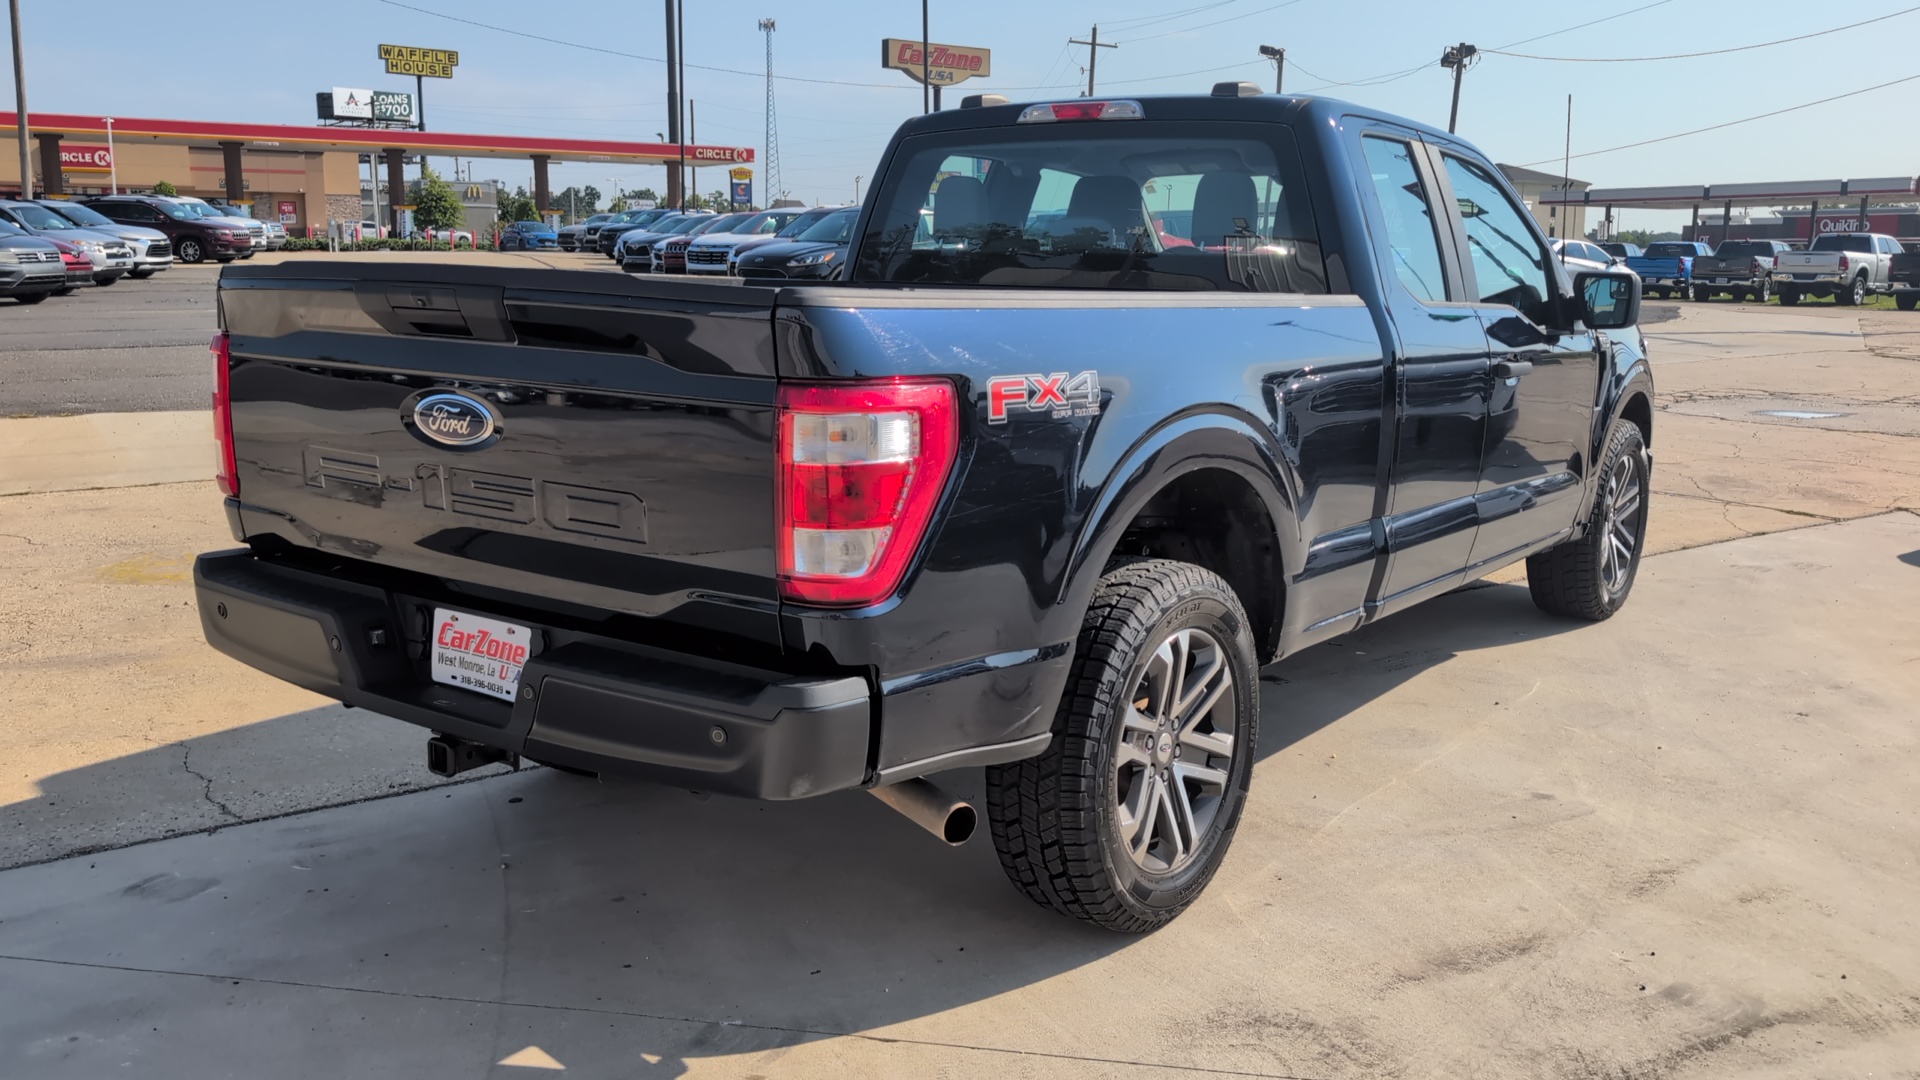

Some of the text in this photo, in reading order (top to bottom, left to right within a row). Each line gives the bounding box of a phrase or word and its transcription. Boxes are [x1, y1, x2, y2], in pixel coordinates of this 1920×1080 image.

[382, 46, 456, 63] WAFFLE
[390, 61, 450, 76] HOUSE
[929, 70, 954, 82] USA
[381, 104, 409, 116] $700
[60, 152, 92, 162] RCLE
[696, 148, 732, 160] CIRCLE
[1820, 219, 1870, 232] QuikTrp
[986, 370, 1101, 425] FX4
[428, 404, 471, 434] Ford
[302, 445, 647, 544] F-150
[438, 622, 526, 668] CarZone
[438, 651, 457, 668] West
[458, 656, 486, 677] Monroe,
[487, 663, 496, 677] La
[460, 674, 504, 694] 318-396-0039
